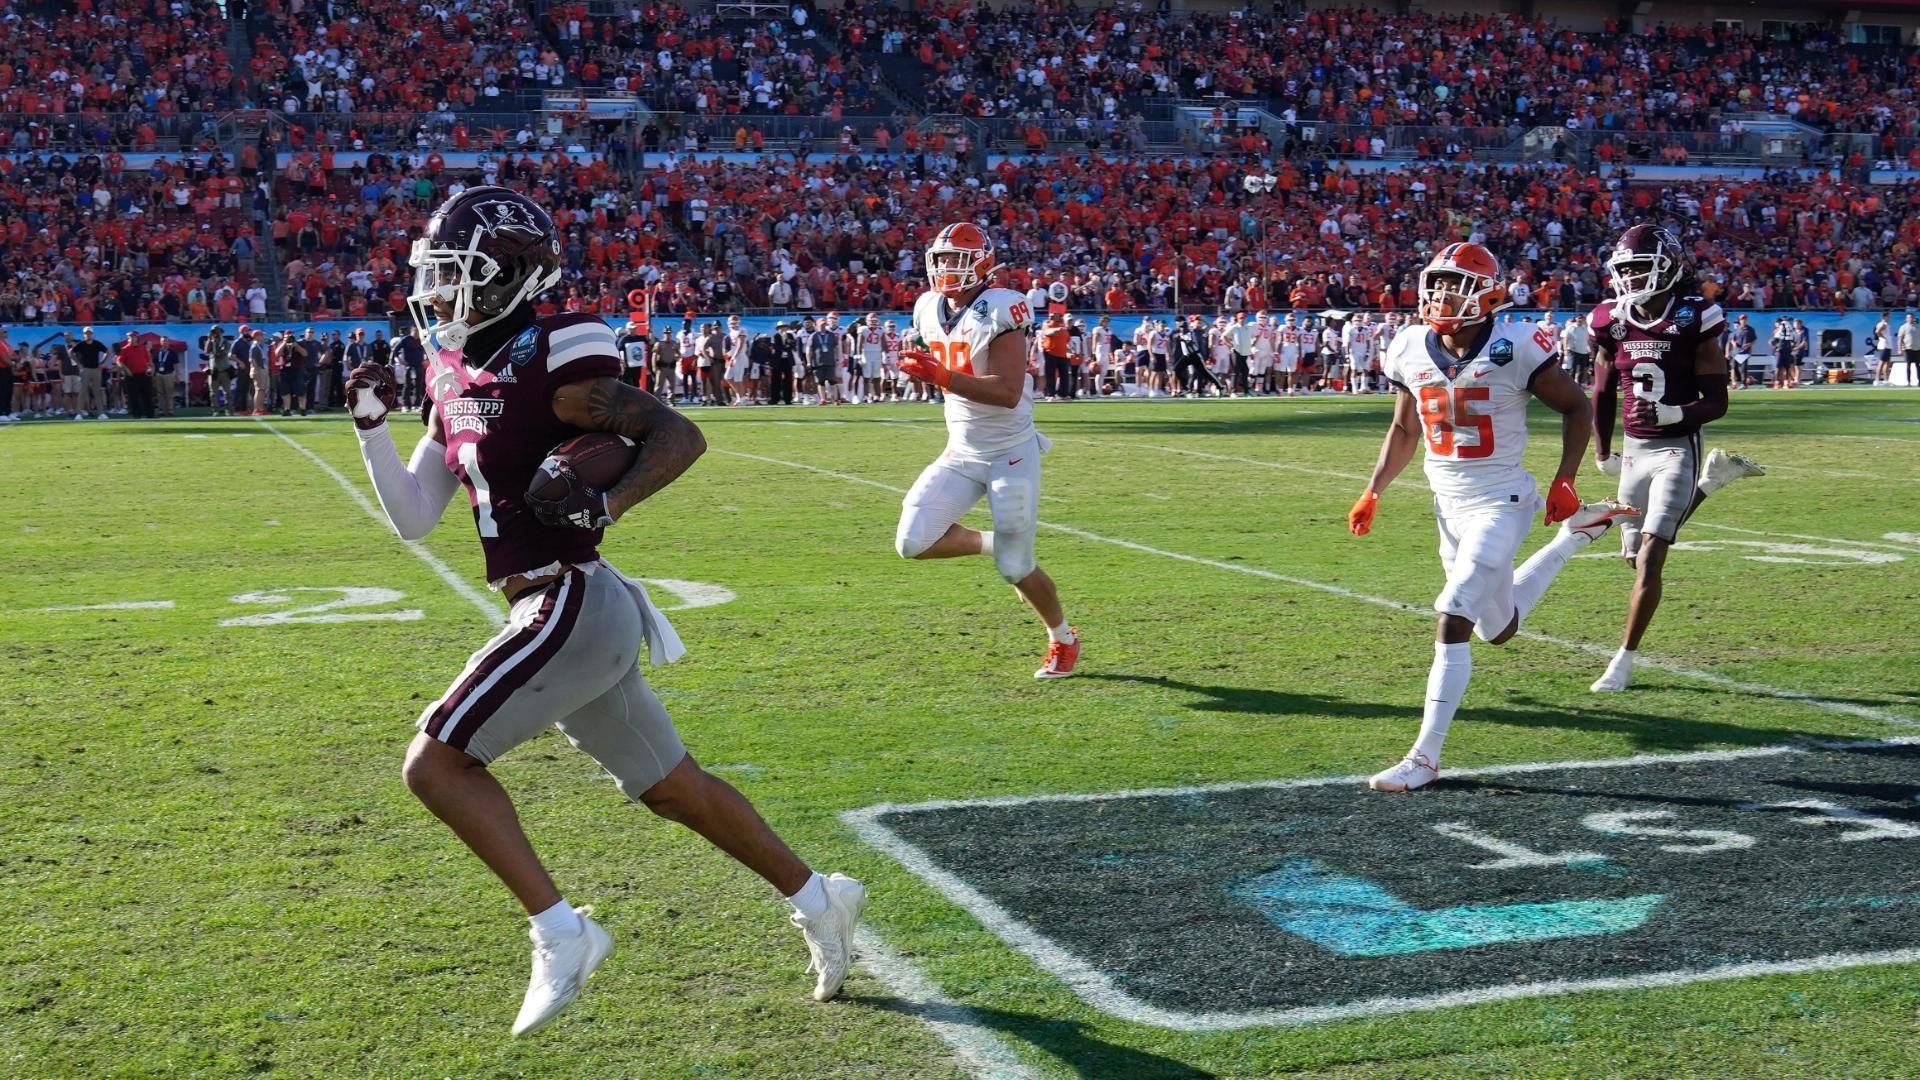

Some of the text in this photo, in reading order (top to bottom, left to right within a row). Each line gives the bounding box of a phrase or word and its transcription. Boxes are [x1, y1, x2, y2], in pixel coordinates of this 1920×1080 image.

[1622, 342, 1671, 350] MISSISSIPPI
[491, 374, 518, 384] adidas
[1632, 363, 1665, 402] 3
[444, 401, 504, 416] MISSISSIPPI
[456, 416, 481, 431] STATE
[1419, 386, 1495, 459] 85
[457, 442, 500, 538] 1
